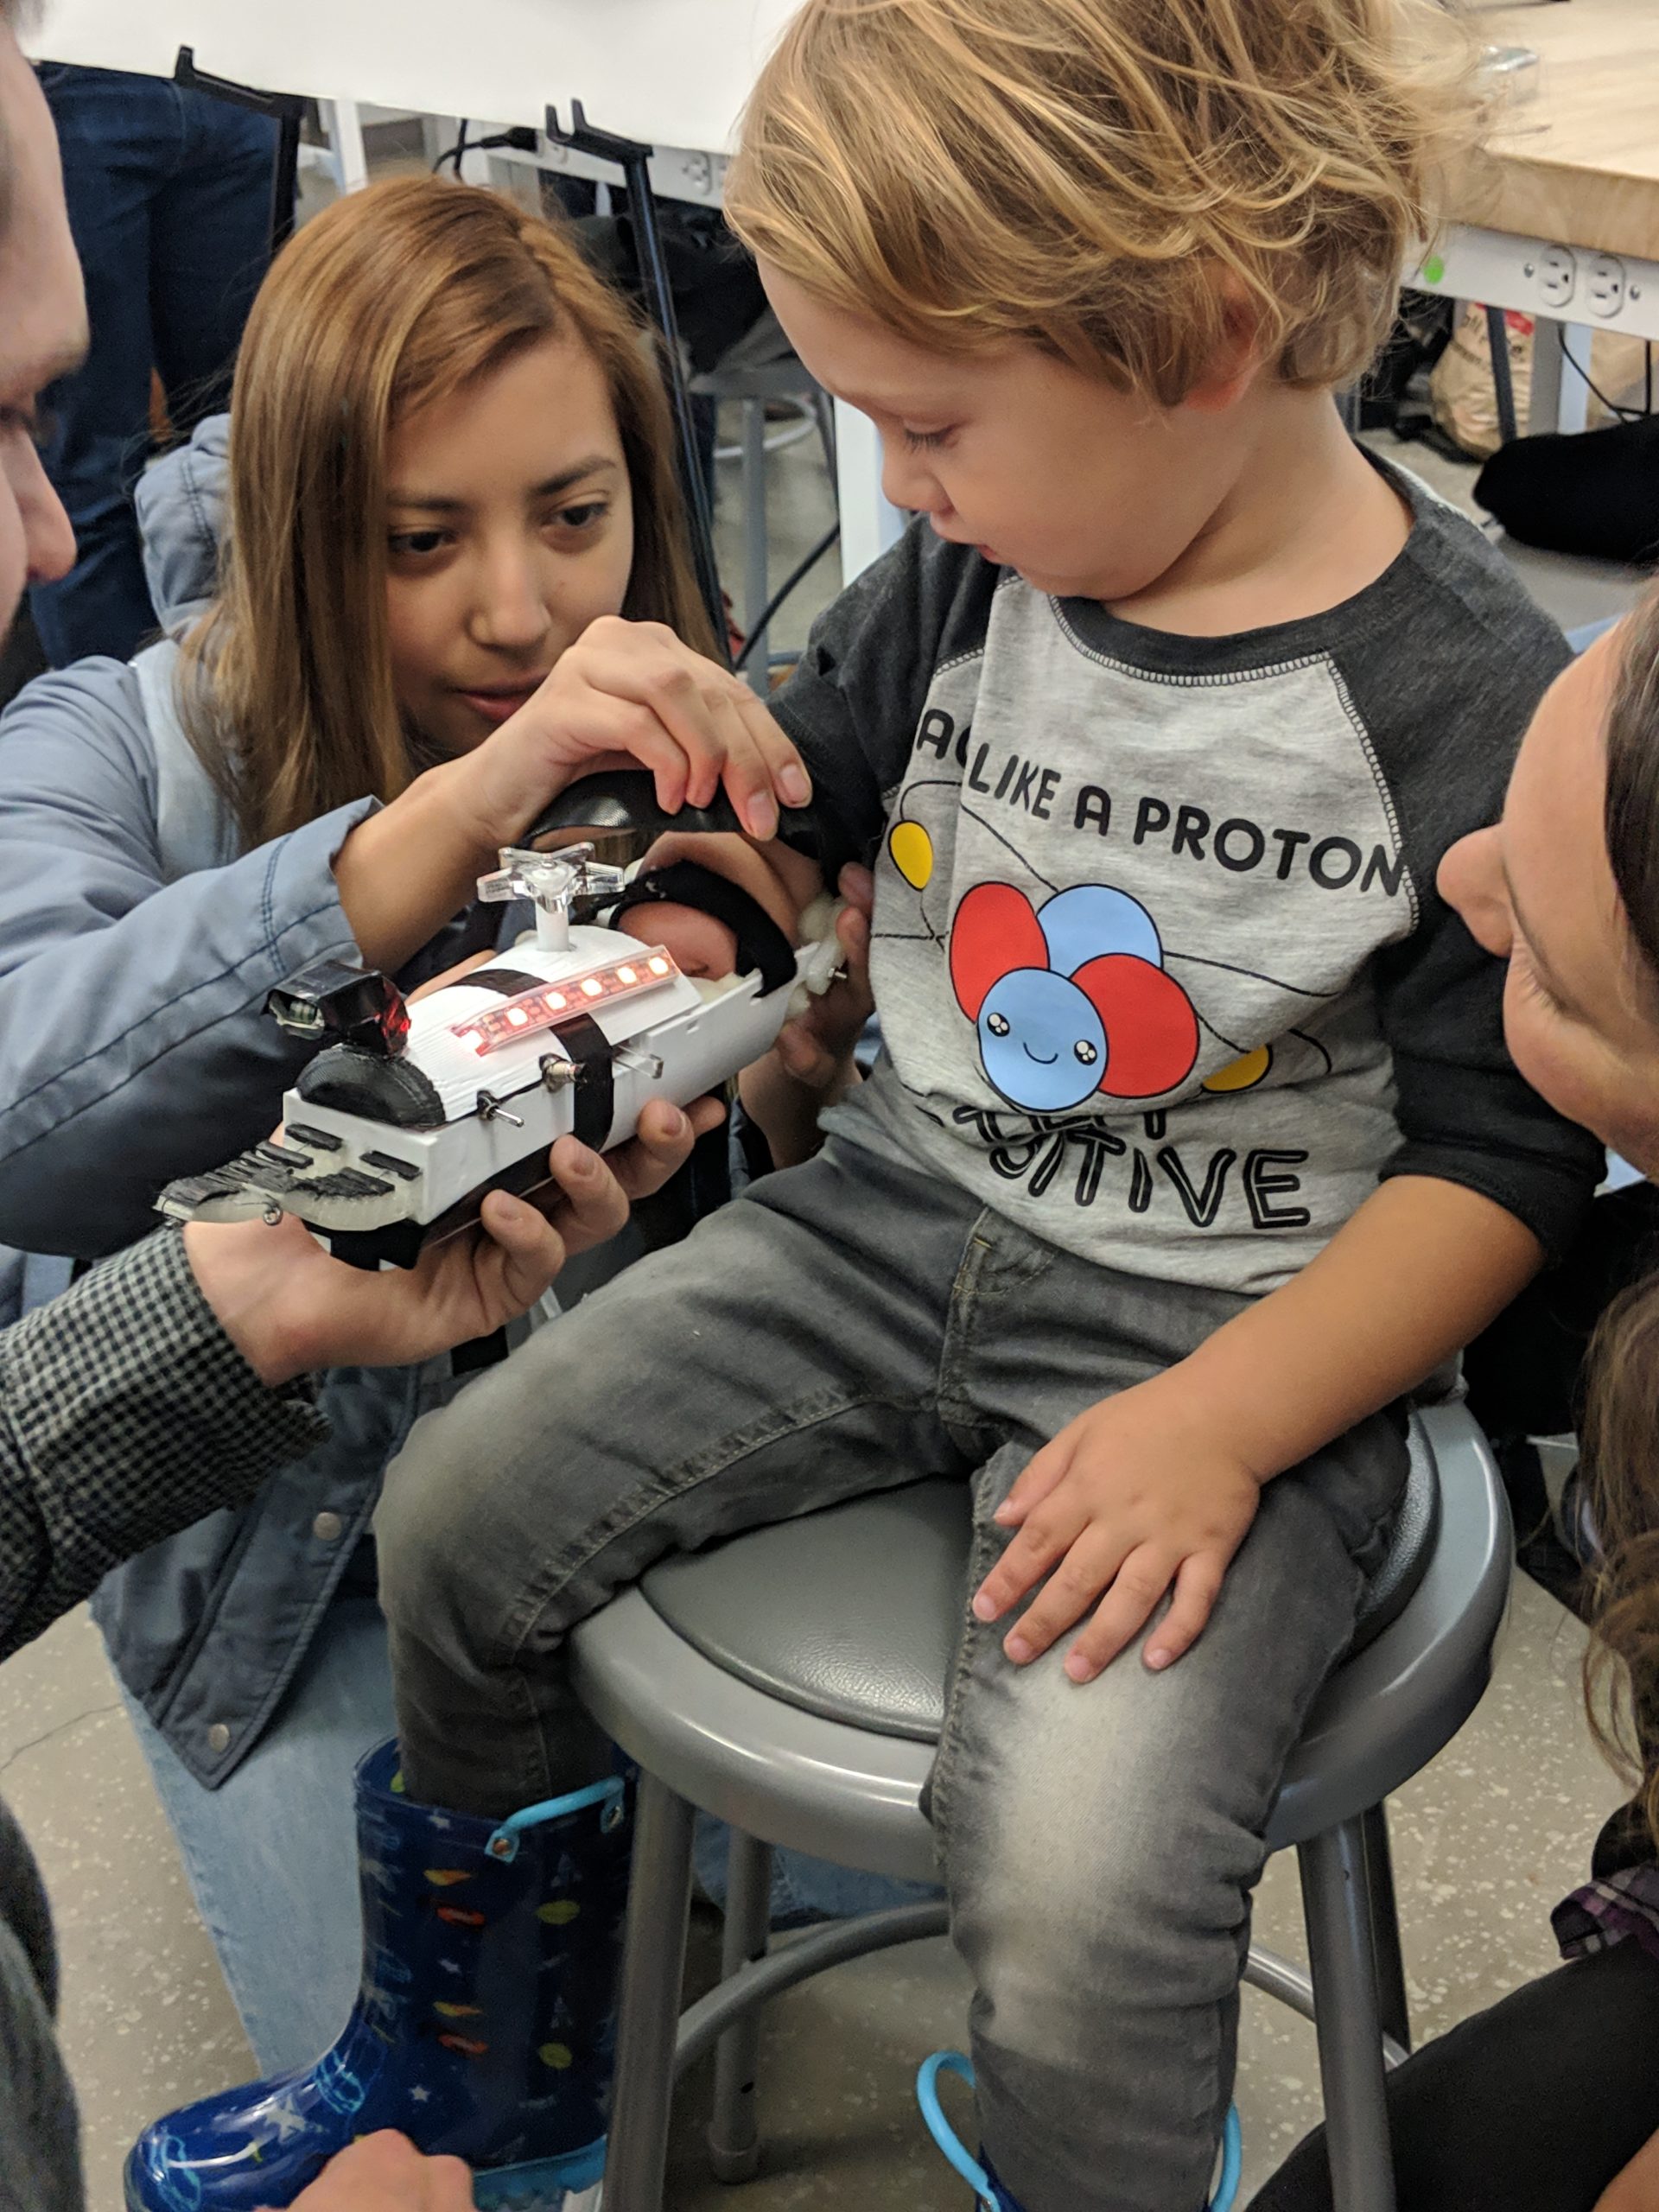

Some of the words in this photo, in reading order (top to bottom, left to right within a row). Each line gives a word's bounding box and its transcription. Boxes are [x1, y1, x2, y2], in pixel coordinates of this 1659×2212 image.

[969, 742, 1062, 820] LIKE
[1073, 785, 1111, 836] A
[1133, 797, 1405, 897] PROTON
